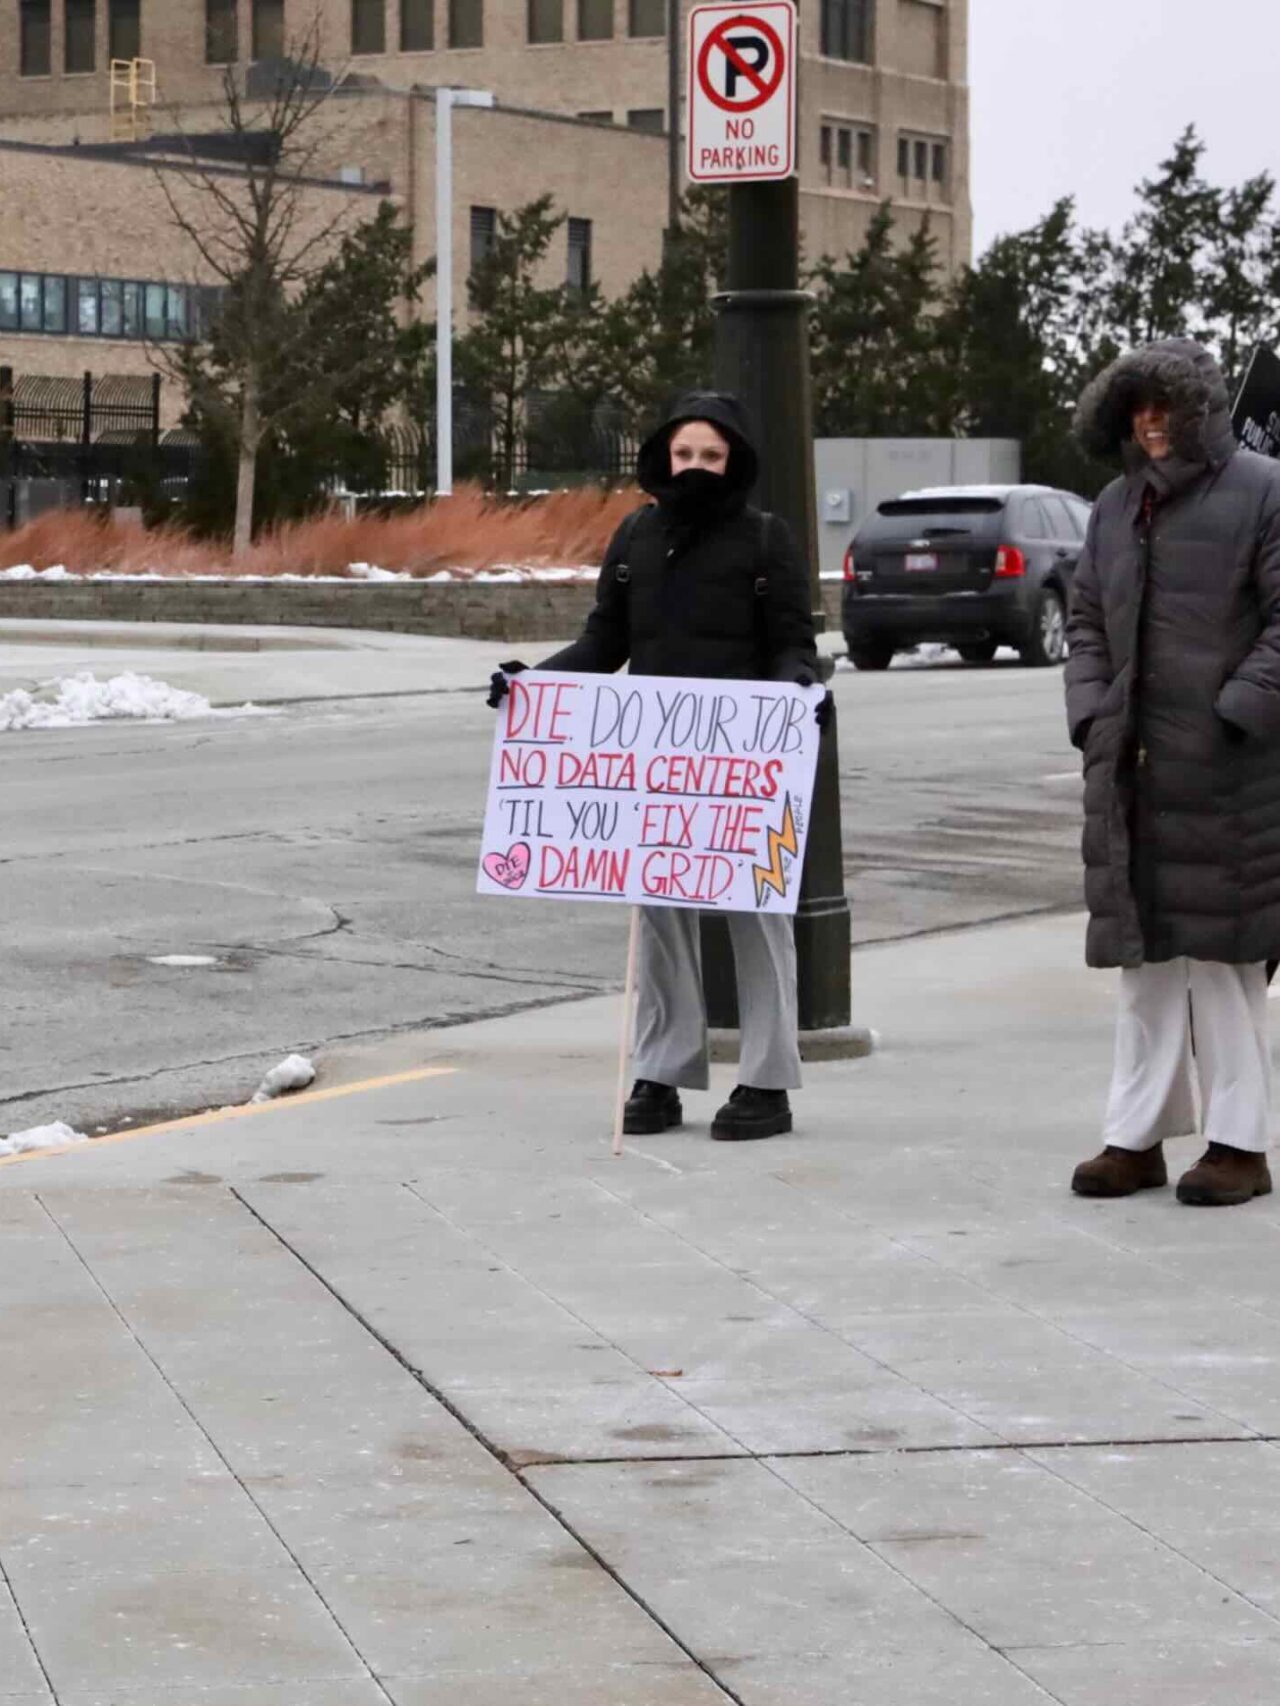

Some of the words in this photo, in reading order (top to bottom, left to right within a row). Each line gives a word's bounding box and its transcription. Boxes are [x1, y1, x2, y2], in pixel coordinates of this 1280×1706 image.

[725, 118, 754, 140] NO
[700, 144, 779, 169] PARKING
[590, 684, 643, 749] DO
[653, 690, 738, 753] YOUR
[743, 694, 807, 754] JOB.
[500, 747, 547, 787] NO
[558, 752, 635, 790] DATA
[646, 755, 783, 798] CENTERS
[566, 800, 619, 841] YOU
[709, 804, 764, 855] THE
[539, 845, 630, 892] DAMN
